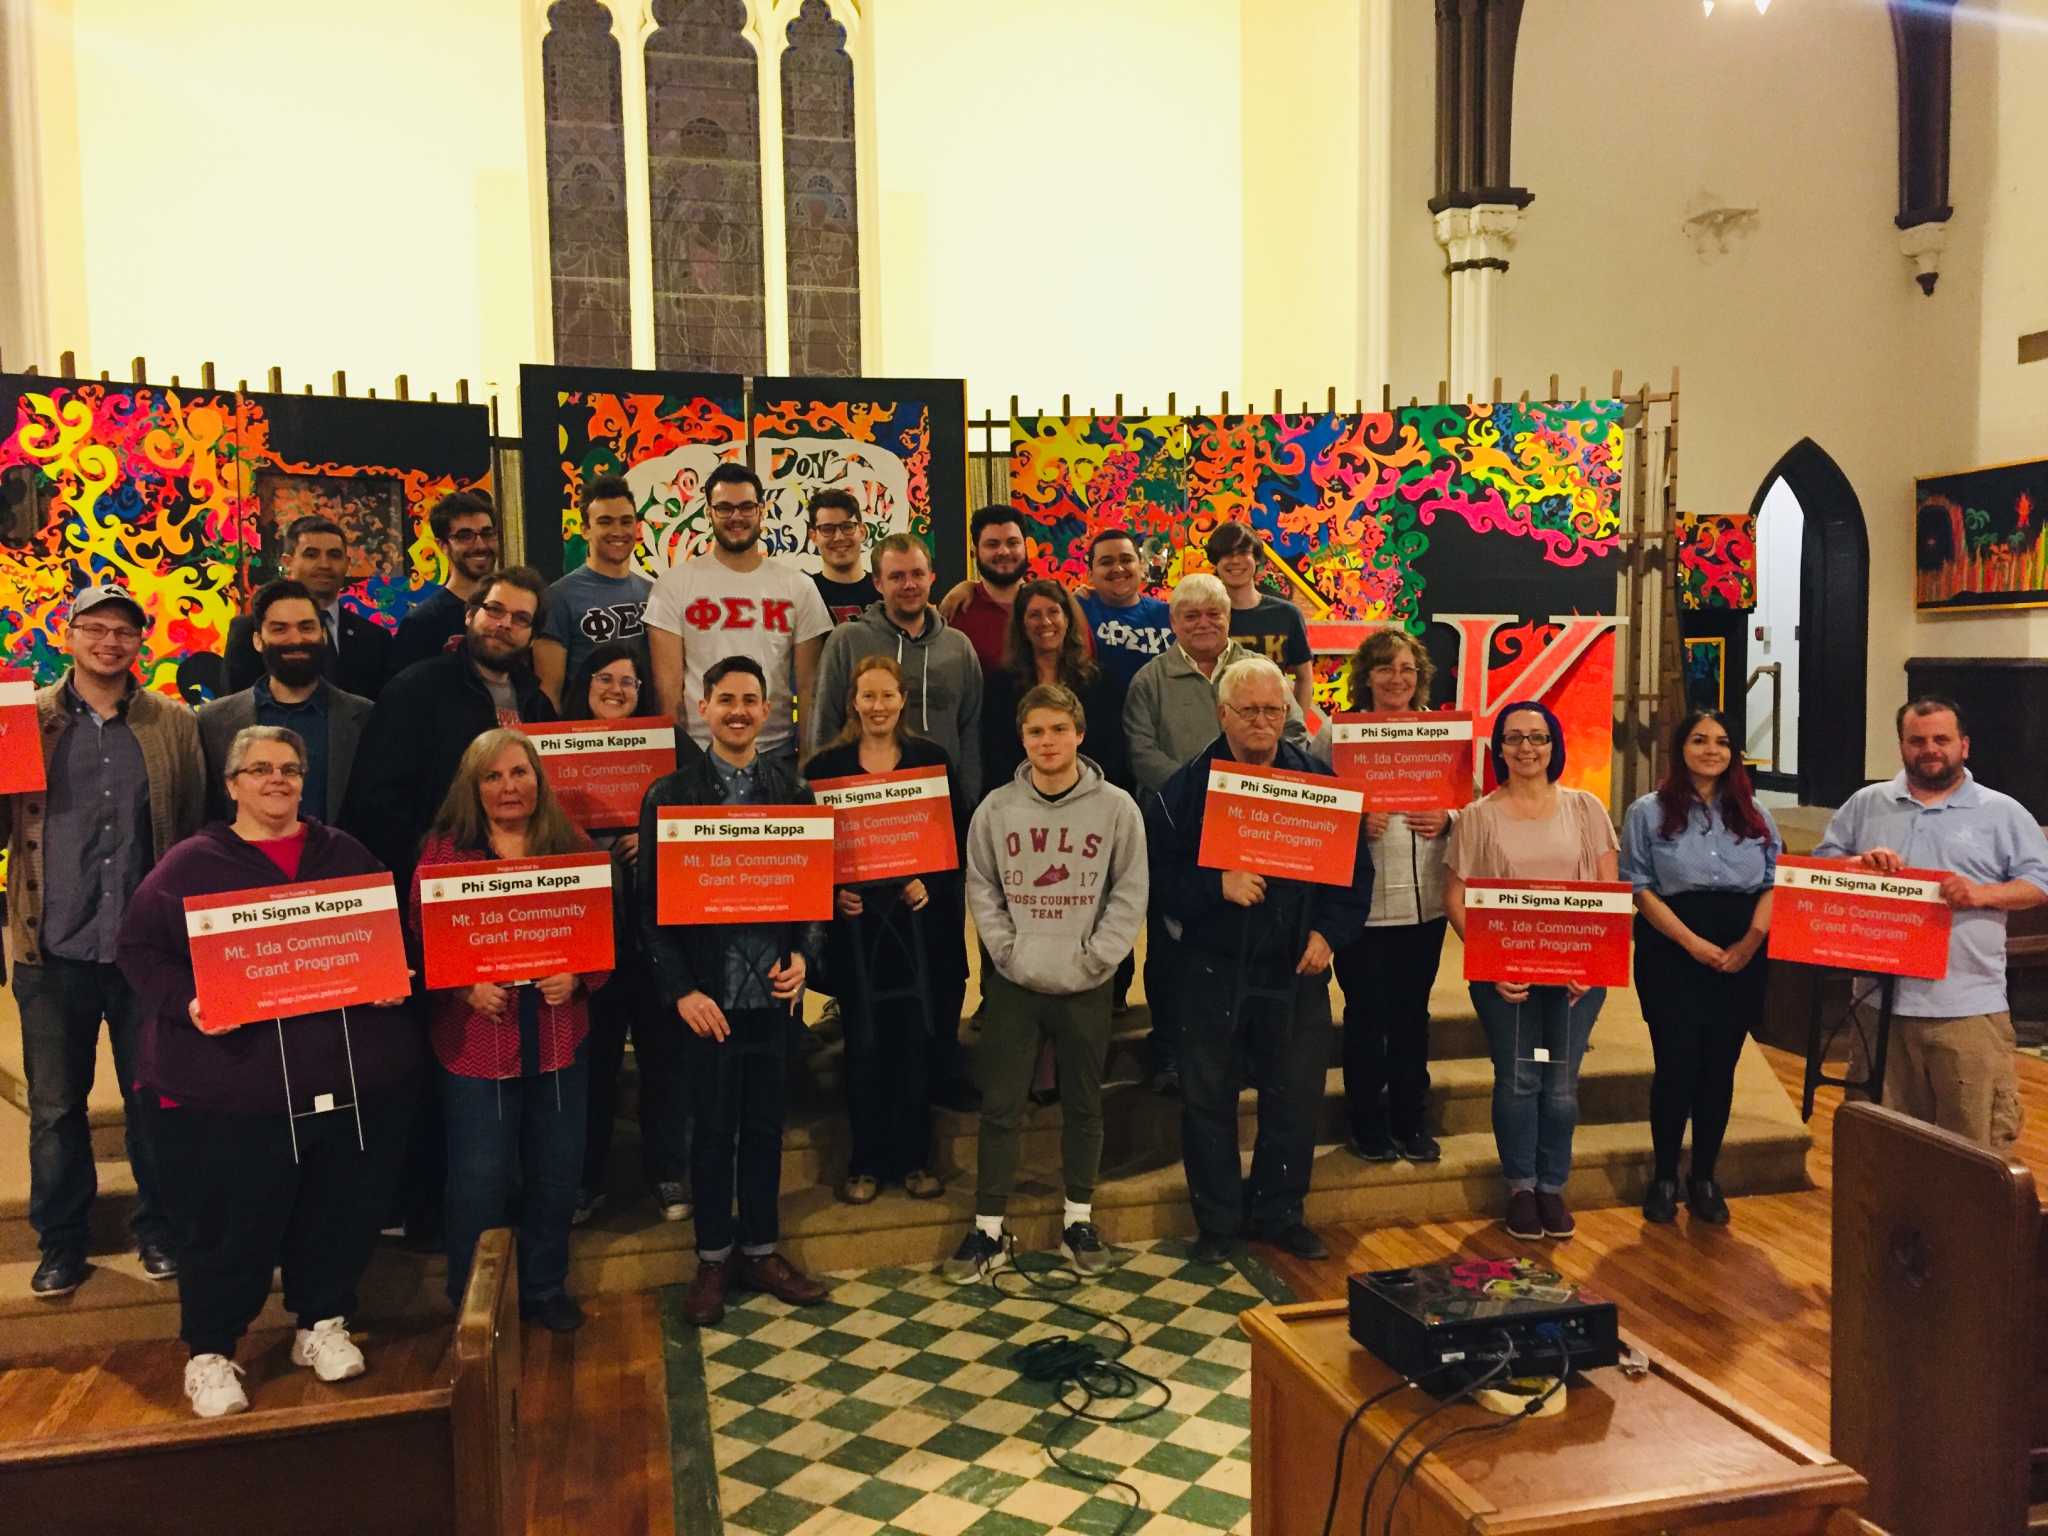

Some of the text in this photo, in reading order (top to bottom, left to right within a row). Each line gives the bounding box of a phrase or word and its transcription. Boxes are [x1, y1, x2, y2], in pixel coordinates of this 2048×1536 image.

[1361, 727, 1449, 739] Phi Sigma Kappa
[541, 736, 647, 750] Phi Sigma Kappa
[1354, 752, 1453, 764] Mt. Ida Community
[558, 763, 652, 778] Ida Community
[1366, 770, 1442, 781] Grant Program
[587, 782, 640, 795] Program
[823, 785, 922, 805] Phi Sigma Kappa
[1240, 781, 1337, 804] Phi Sigma Kappa
[840, 812, 929, 832] Ida Community
[1228, 806, 1337, 832] Mt. Ida Community
[694, 824, 805, 837] Phi Sigma Kappa
[870, 831, 919, 846] Program
[1238, 826, 1322, 848] Grant Program
[1006, 827, 1103, 858] OWLS
[683, 854, 808, 867] Mt. Ida Community
[462, 874, 580, 893] Phi Sigma Kappa
[699, 873, 794, 887] Grant Program
[1004, 870, 1098, 887] 20 17
[1811, 874, 1923, 897] Phi Sigma Kappa
[1040, 895, 1095, 906] COUNTRY
[1499, 894, 1603, 908] Phi Sigma Kappa
[232, 897, 363, 924] Phi Sigma Kappa
[452, 904, 586, 927] Mt. Ida Community
[1031, 909, 1063, 919] TEAM
[1824, 903, 1844, 915] Ida
[1850, 905, 1924, 926] Community
[469, 925, 572, 945] Grant Program
[1488, 920, 1607, 937] Mt. Ida Community
[1809, 919, 1909, 940] Grant Program
[224, 928, 372, 961] Mt. Ida Community
[1502, 938, 1591, 952] Grant Program
[246, 951, 359, 979] Grant Program
